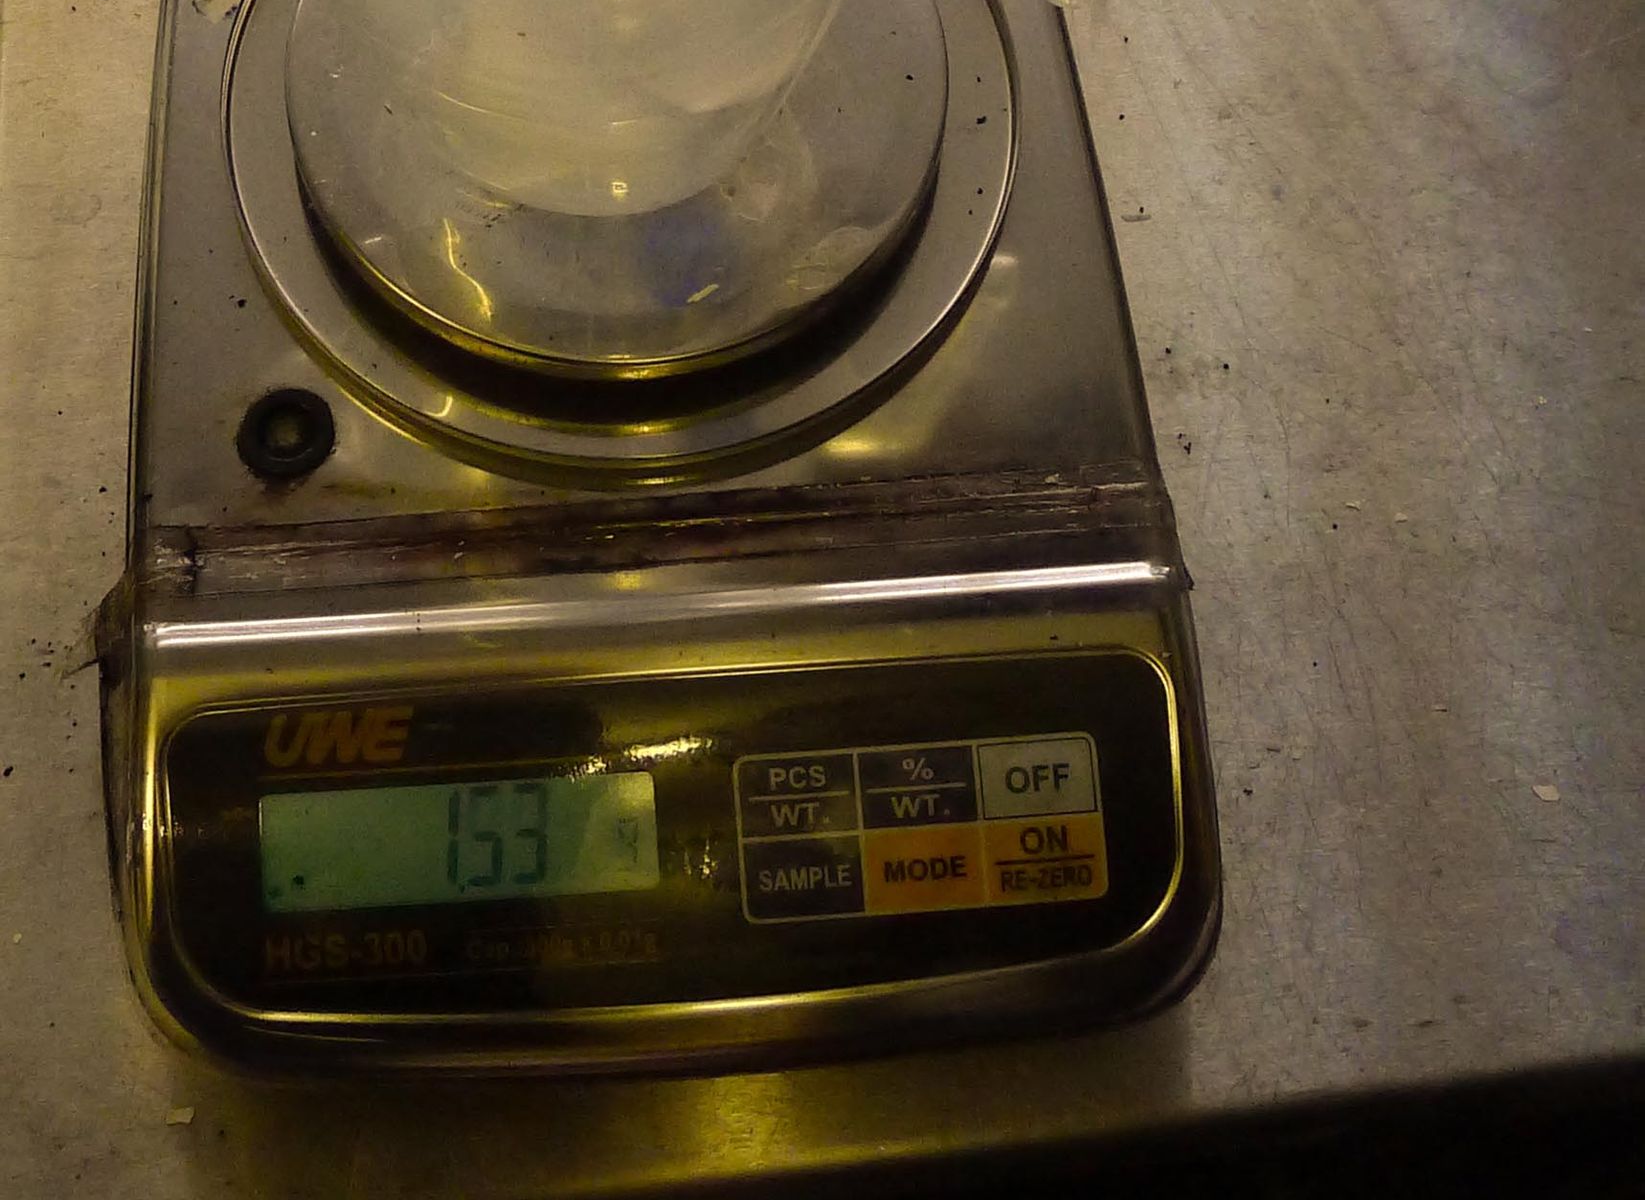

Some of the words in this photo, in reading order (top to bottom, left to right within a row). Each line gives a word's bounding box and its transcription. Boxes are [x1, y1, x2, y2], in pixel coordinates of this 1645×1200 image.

[264, 705, 416, 767] UWE
[769, 764, 827, 791] PCS
[1004, 762, 1070, 795] OFF
[1019, 825, 1068, 854] ON
[759, 863, 852, 893] SAMPLE
[884, 855, 967, 883] MODE
[1001, 863, 1093, 893] RE-ZERO
